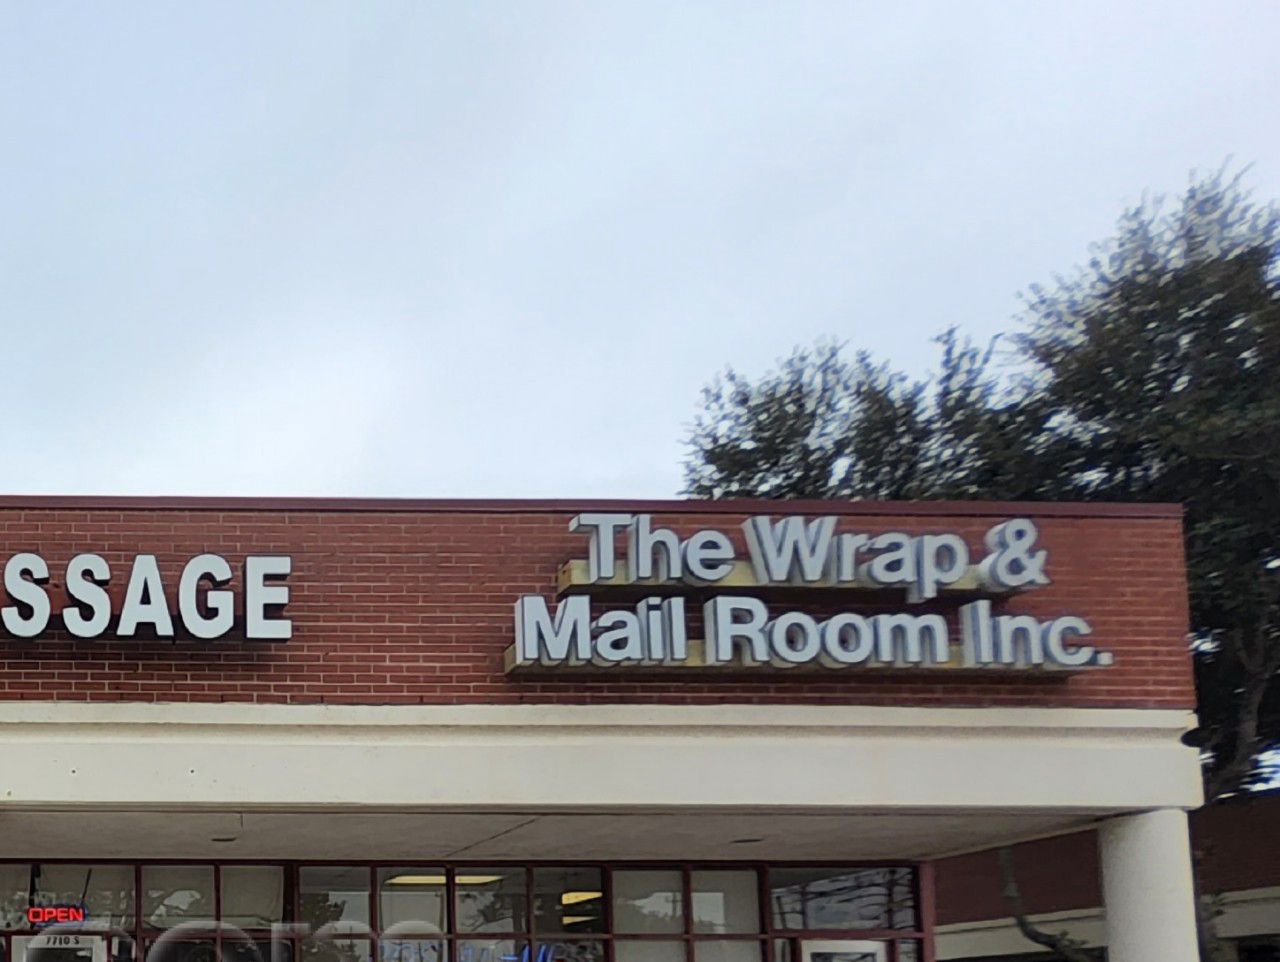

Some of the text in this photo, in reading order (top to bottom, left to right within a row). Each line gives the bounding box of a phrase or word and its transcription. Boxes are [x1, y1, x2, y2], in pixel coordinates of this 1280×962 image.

[569, 513, 1050, 603] The Wrap &
[516, 595, 1114, 668] Mail Room Inc.
[28, 907, 84, 923] OPEN
